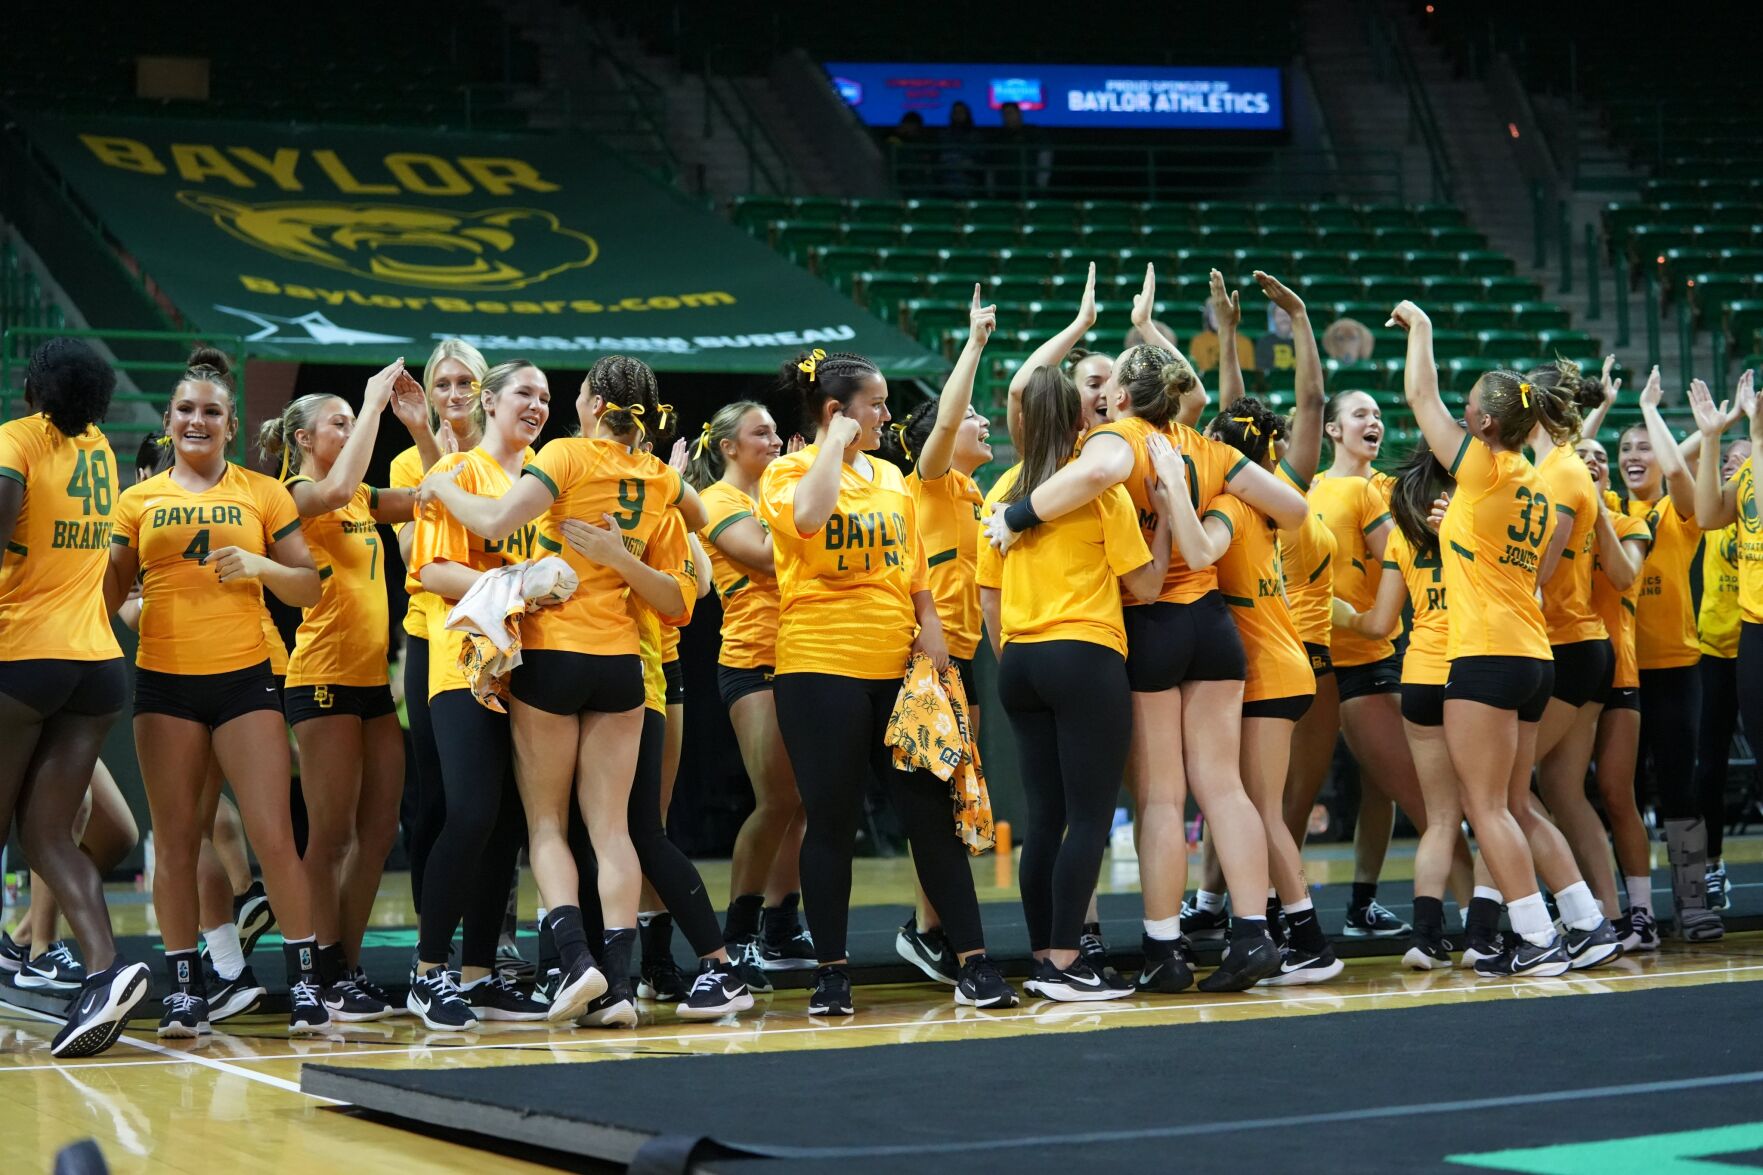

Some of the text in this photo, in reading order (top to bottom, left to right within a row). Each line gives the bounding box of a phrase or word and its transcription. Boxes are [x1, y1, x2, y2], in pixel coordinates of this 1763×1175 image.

[1068, 90, 1270, 113] BAYLOR ATHLETICS
[79, 134, 563, 196] BAYLOR
[239, 274, 736, 314] BaylorBears.com
[693, 324, 856, 349] BUREAU
[66, 449, 111, 516] 48
[153, 505, 242, 528] BAYLOR
[613, 478, 645, 530] 9
[1508, 486, 1548, 548] 33
[182, 529, 210, 566] 4
[365, 538, 378, 580] 7
